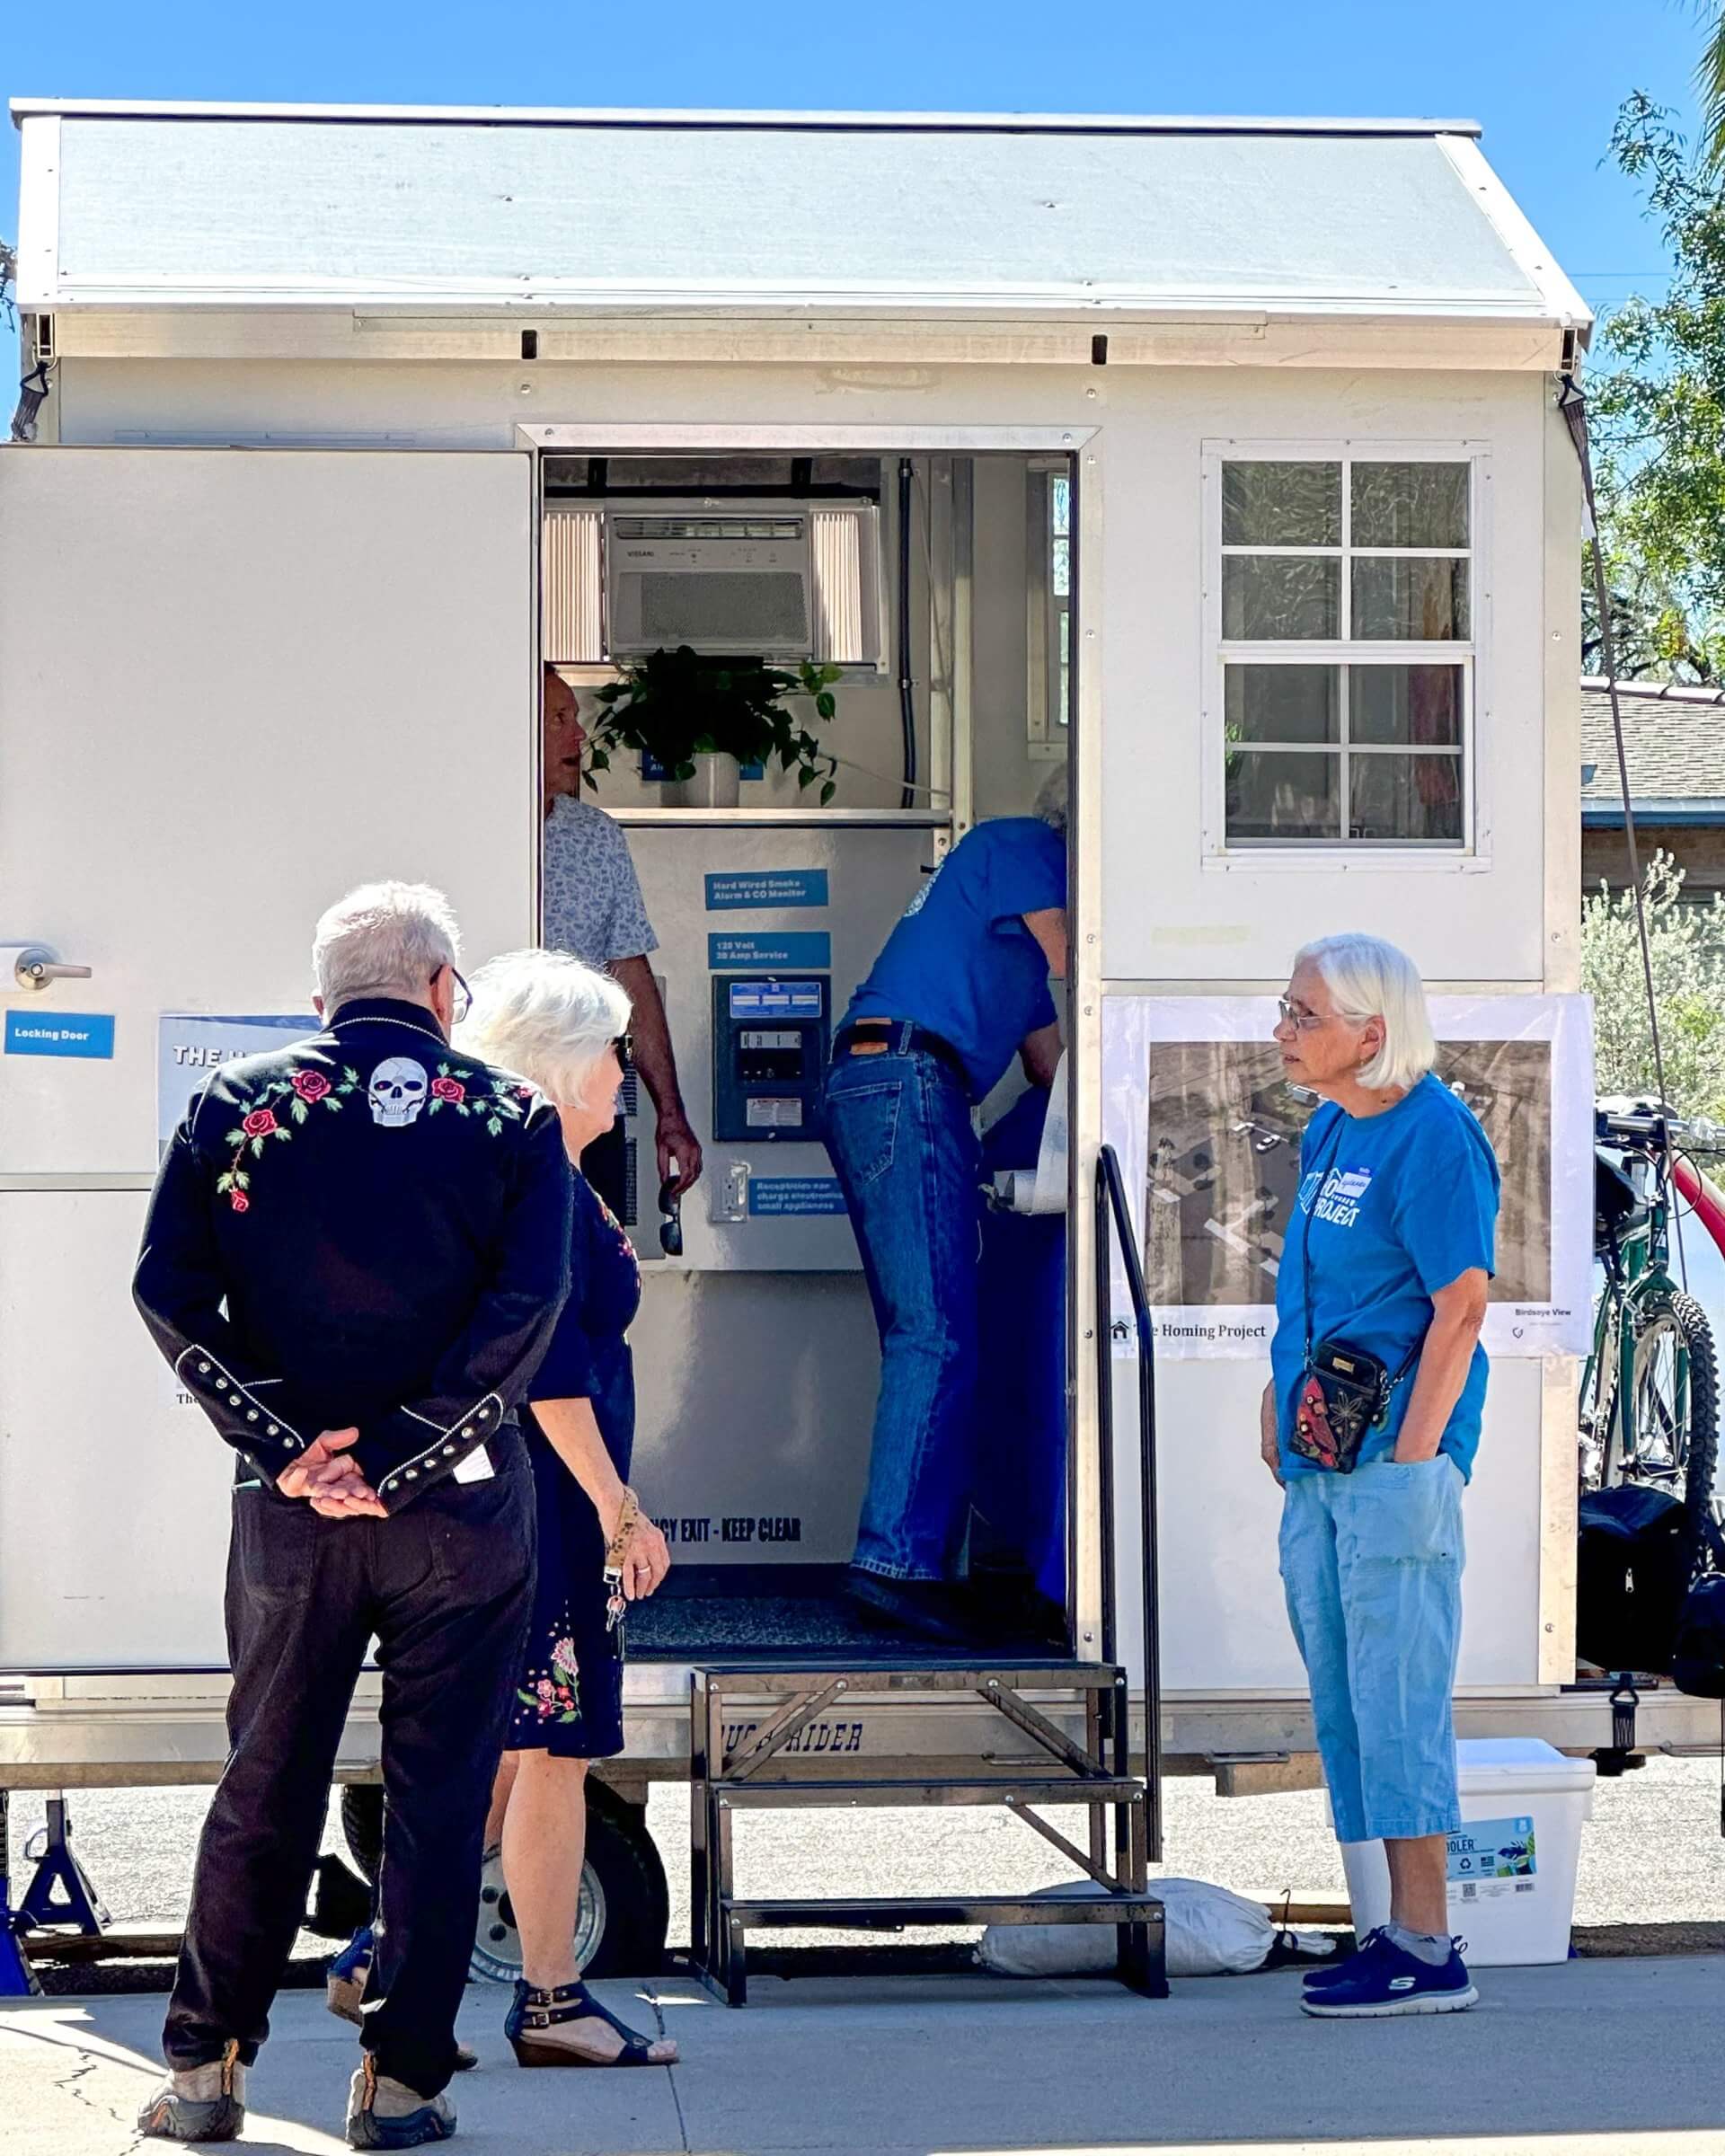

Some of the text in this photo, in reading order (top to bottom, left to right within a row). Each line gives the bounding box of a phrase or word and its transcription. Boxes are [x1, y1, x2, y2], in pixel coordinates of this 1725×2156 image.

[713, 879, 801, 890] Hard Wired Smoke
[713, 891, 743, 900] Alarm
[752, 890, 767, 899] CO
[768, 889, 806, 898] Monitor
[735, 941, 755, 950] Volt
[730, 951, 751, 961] Amp
[753, 951, 789, 960] Service
[14, 1028, 90, 1041] Locking Door
[172, 1045, 223, 1069] THE
[1313, 1196, 1361, 1228] ROJECT
[1515, 1308, 1571, 1317] Birdseye View
[1162, 1323, 1215, 1340] Homing
[1218, 1323, 1267, 1340] Project
[680, 1517, 711, 1542] EXIT
[721, 1517, 756, 1542] KEEP
[757, 1517, 801, 1542] CLEAR
[785, 1723, 863, 1752] RIDER
